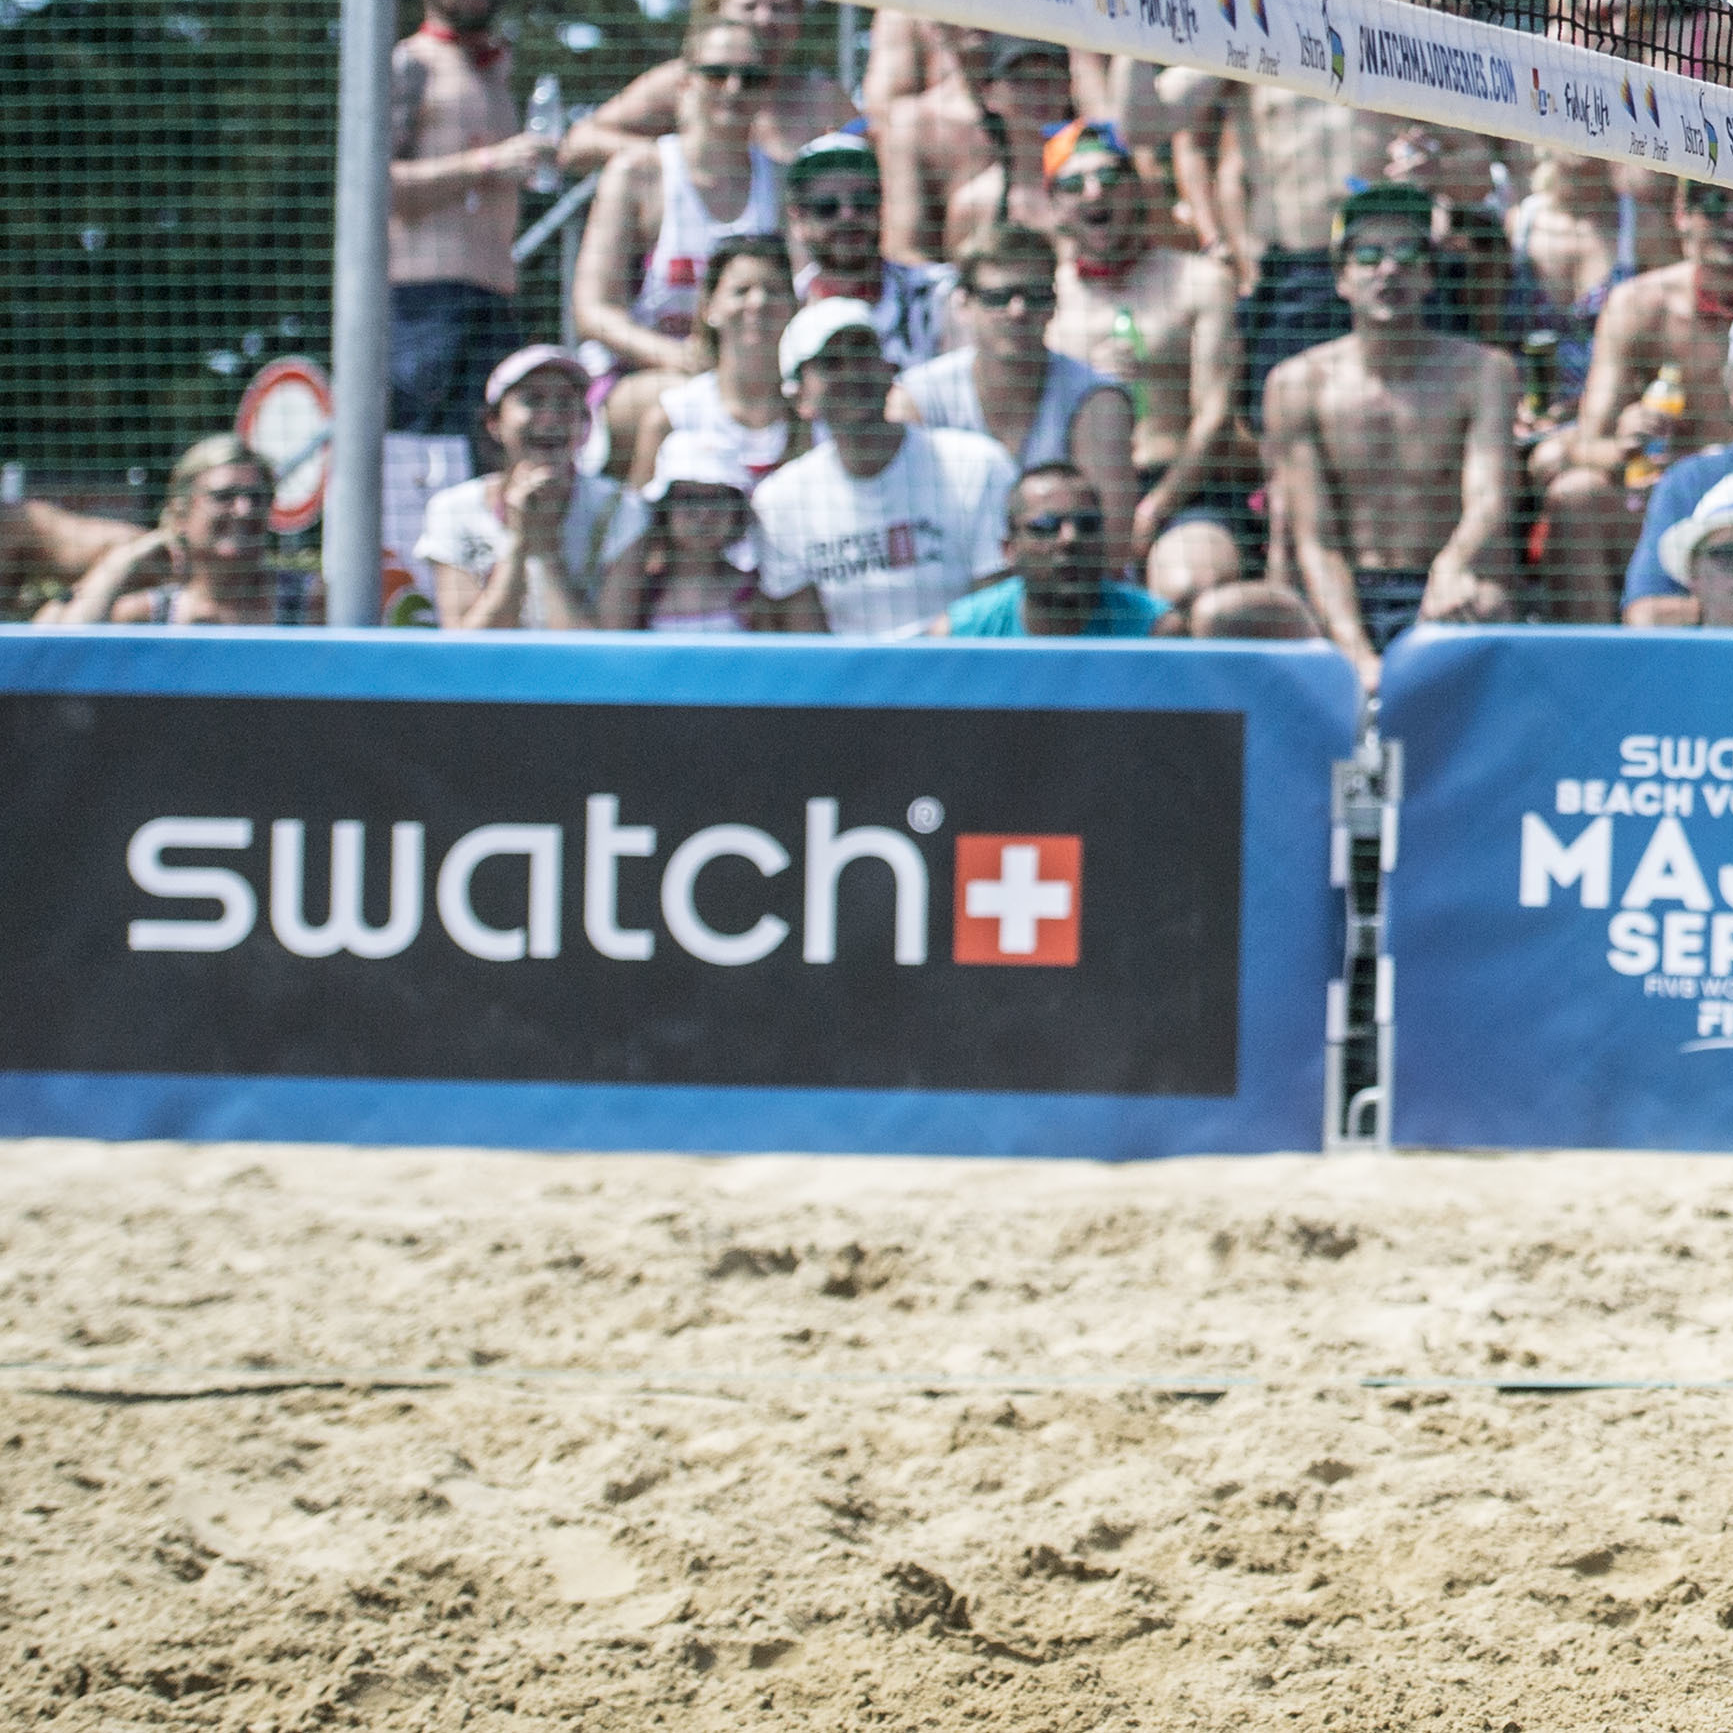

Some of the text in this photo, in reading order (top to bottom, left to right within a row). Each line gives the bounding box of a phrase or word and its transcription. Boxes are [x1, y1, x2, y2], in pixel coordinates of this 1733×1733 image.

[1555, 778, 1694, 818] BEACH
[126, 793, 930, 968] swatch
[1644, 975, 1697, 999] FIVB
